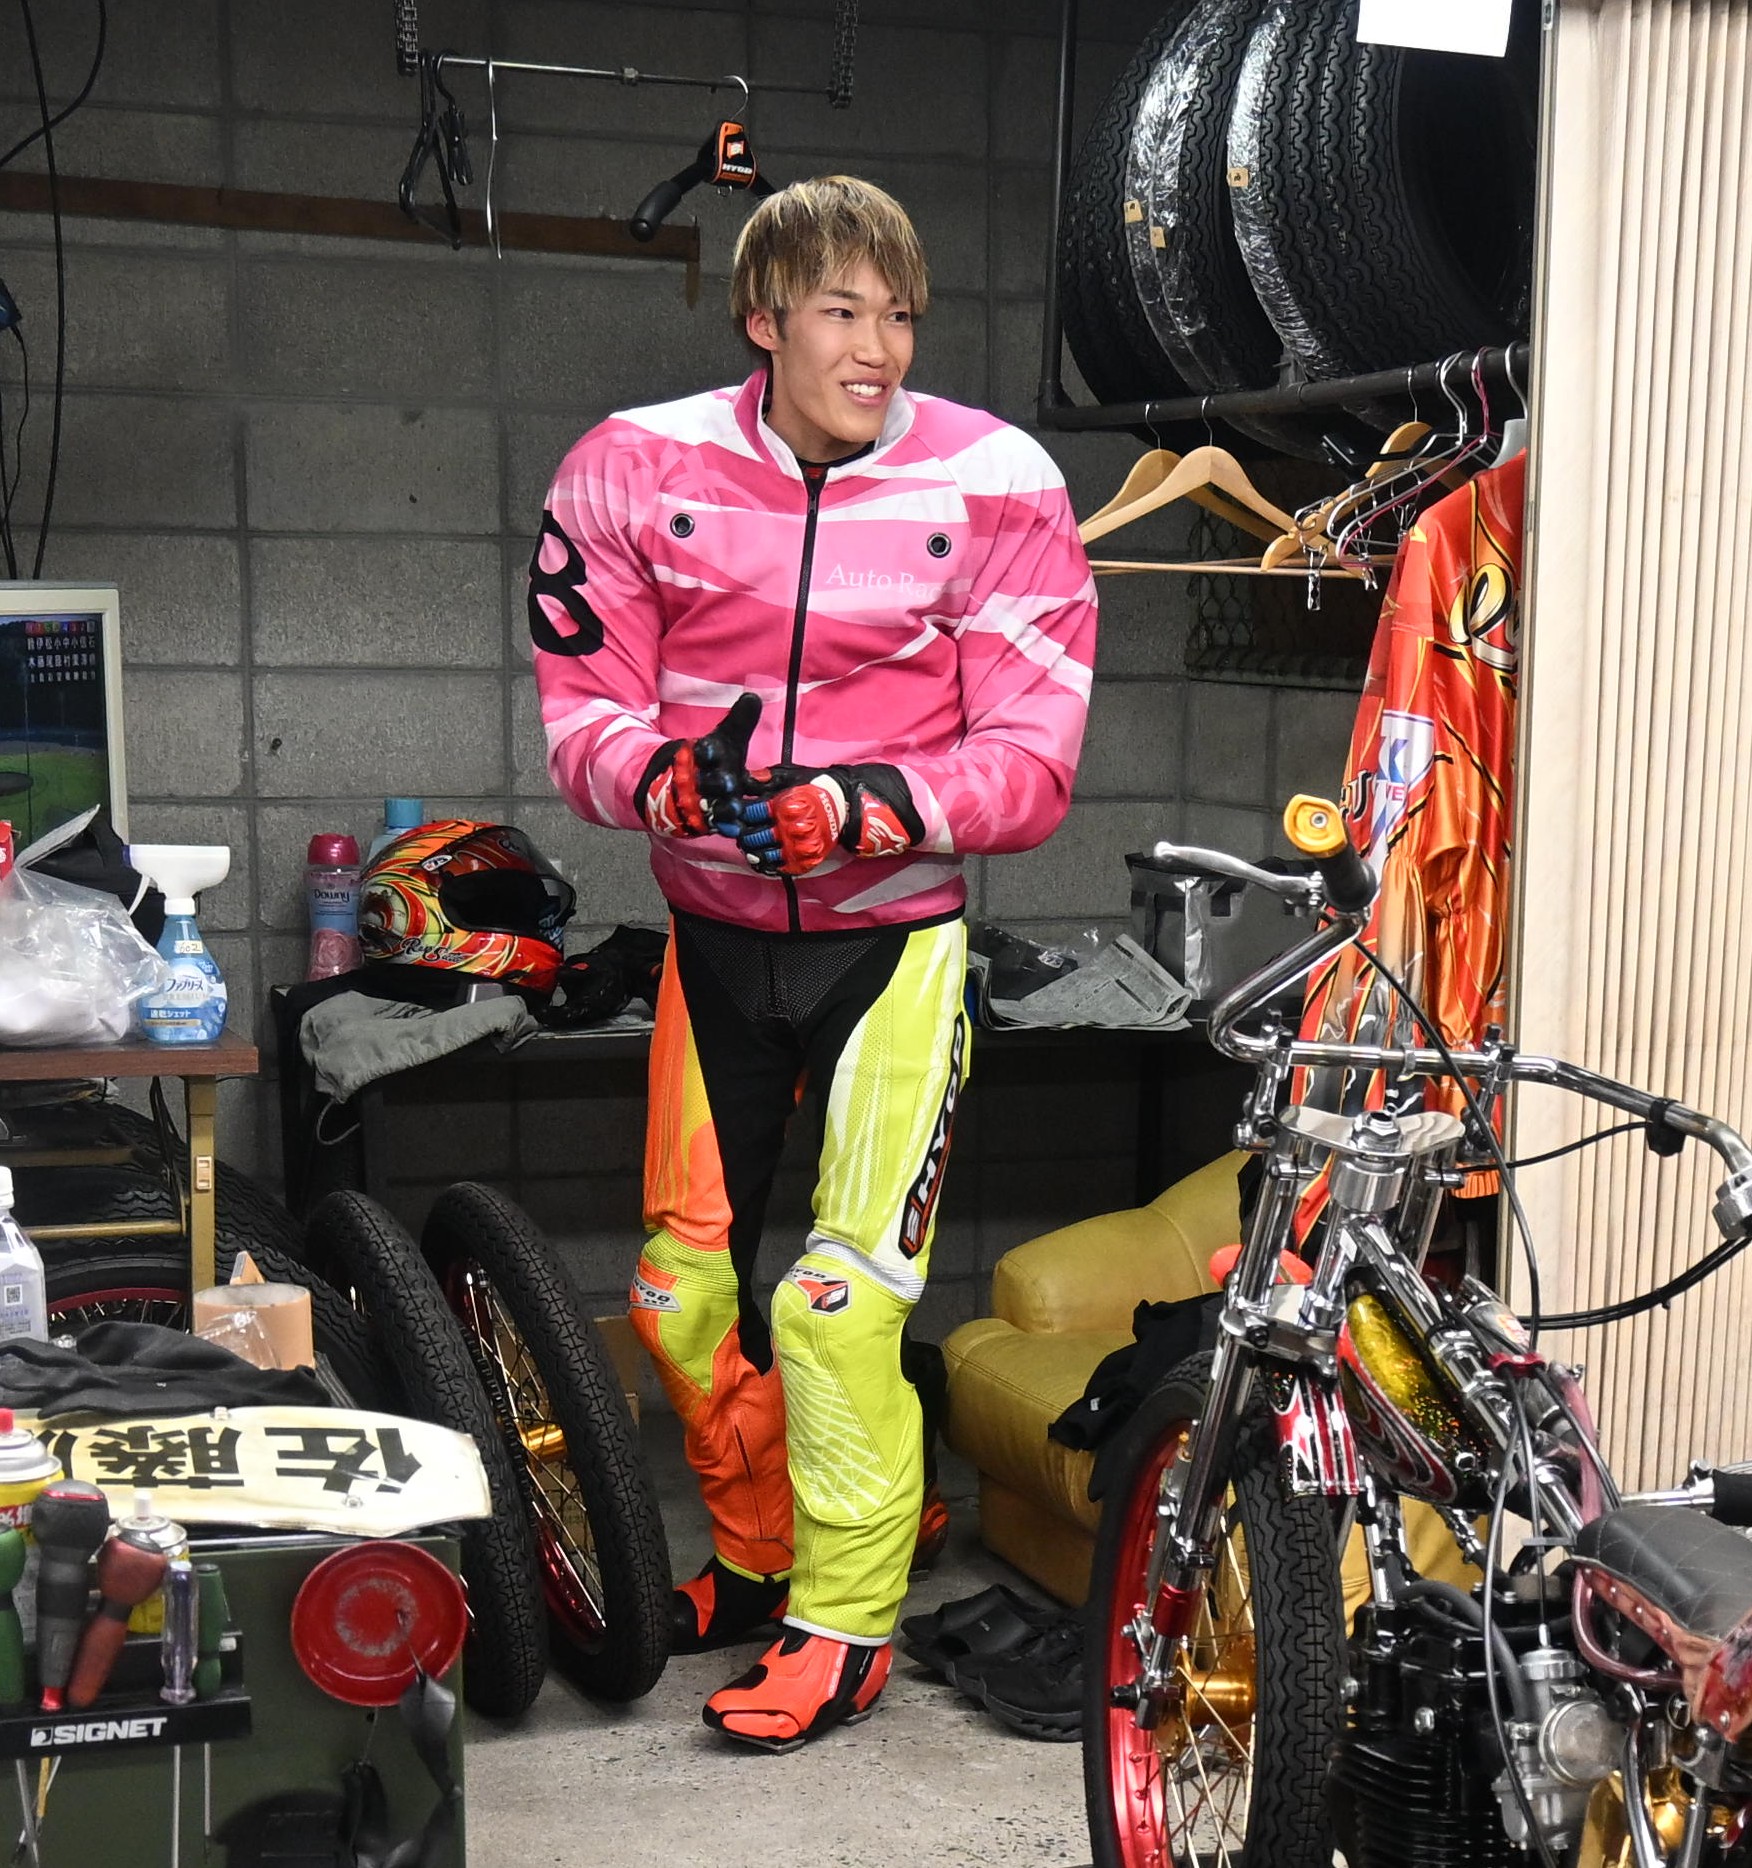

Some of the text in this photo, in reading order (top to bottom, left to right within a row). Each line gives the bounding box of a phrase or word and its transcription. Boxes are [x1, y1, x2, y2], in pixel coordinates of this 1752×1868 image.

[527, 510, 605, 657] 8
[826, 563, 941, 602] Auto Rac
[818, 791, 839, 843] HONDA
[313, 888, 350, 904] Downy
[53, 1717, 168, 1745] SIGNET
